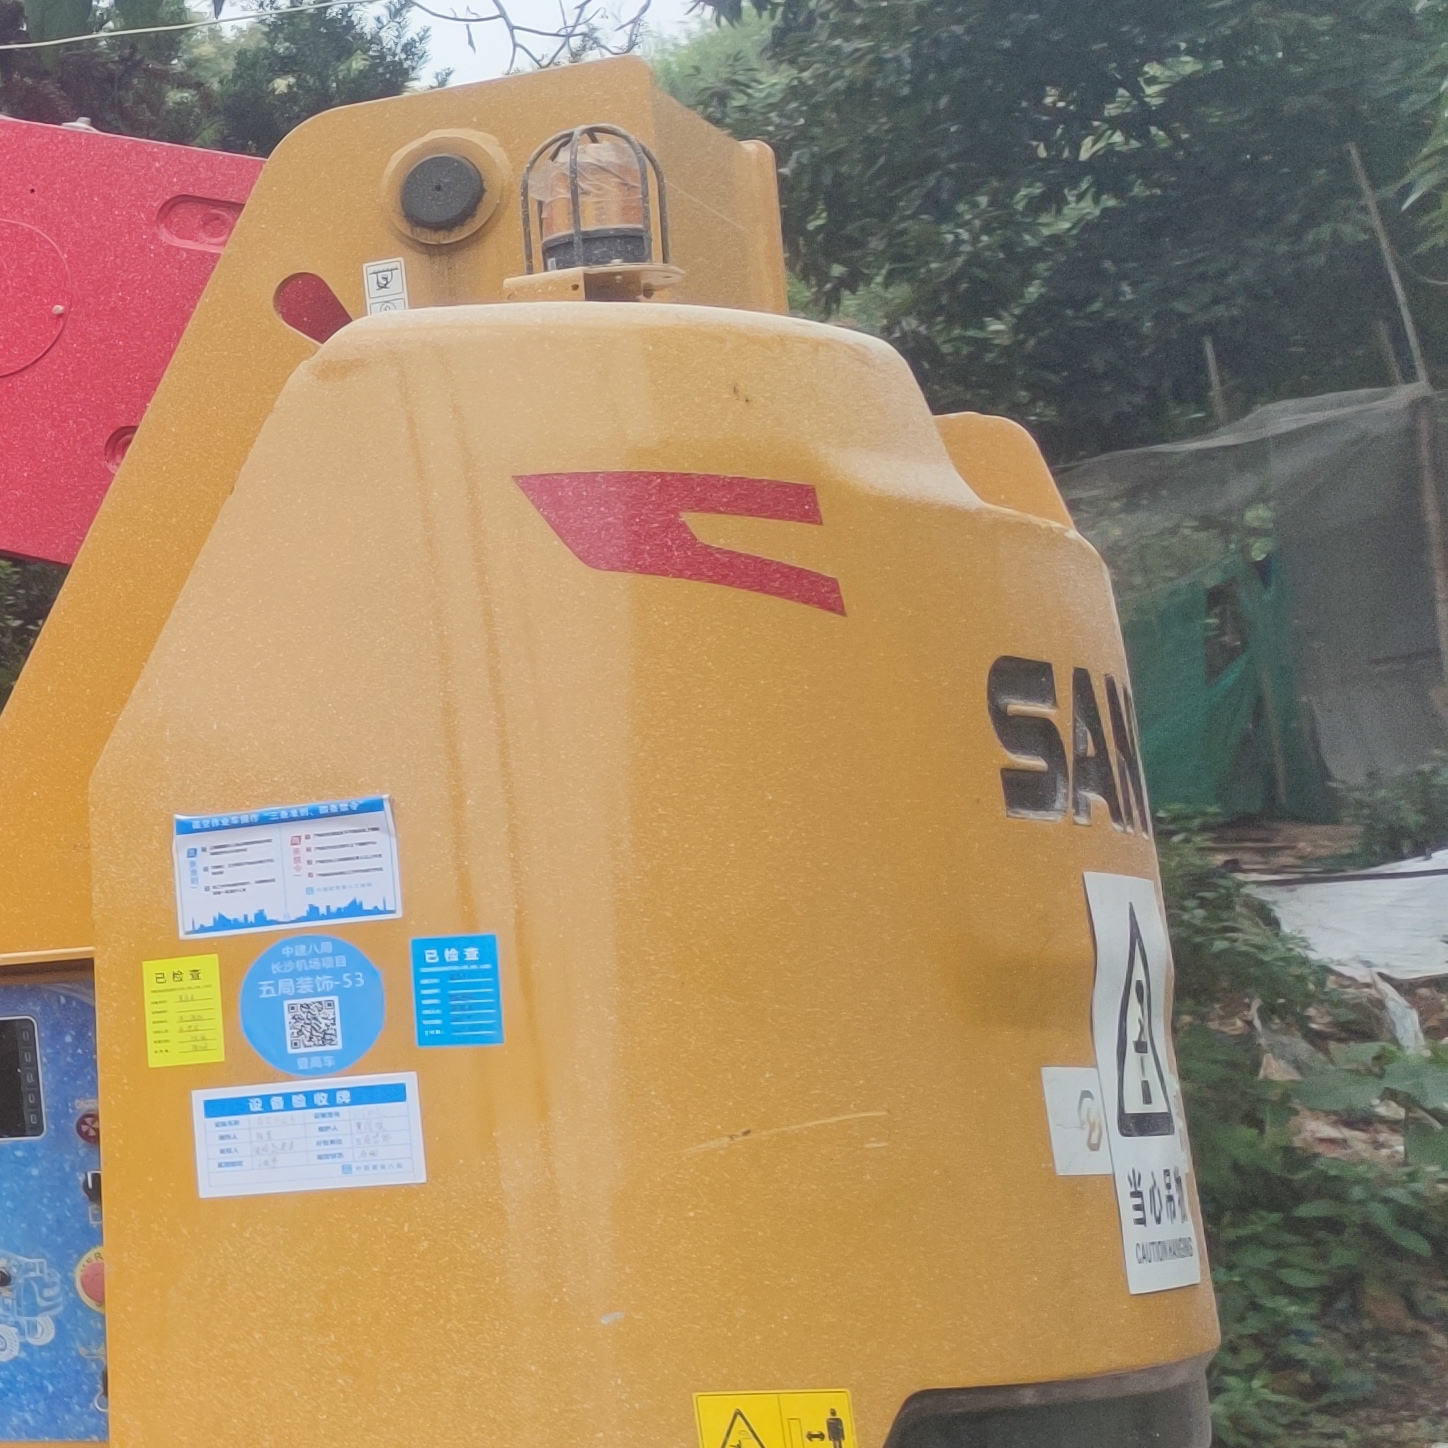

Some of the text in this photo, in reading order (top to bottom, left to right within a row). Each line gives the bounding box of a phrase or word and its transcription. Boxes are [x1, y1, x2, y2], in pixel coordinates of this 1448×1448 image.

[281, 941, 333, 958] 中建八局
[423, 946, 480, 963] 已检查
[270, 954, 347, 975] 长沙机场项目
[154, 968, 202, 984] 已检查
[258, 972, 365, 999] 五局装饰-53
[296, 1055, 336, 1070] 登高车
[248, 1089, 352, 1113] 设备验收牌
